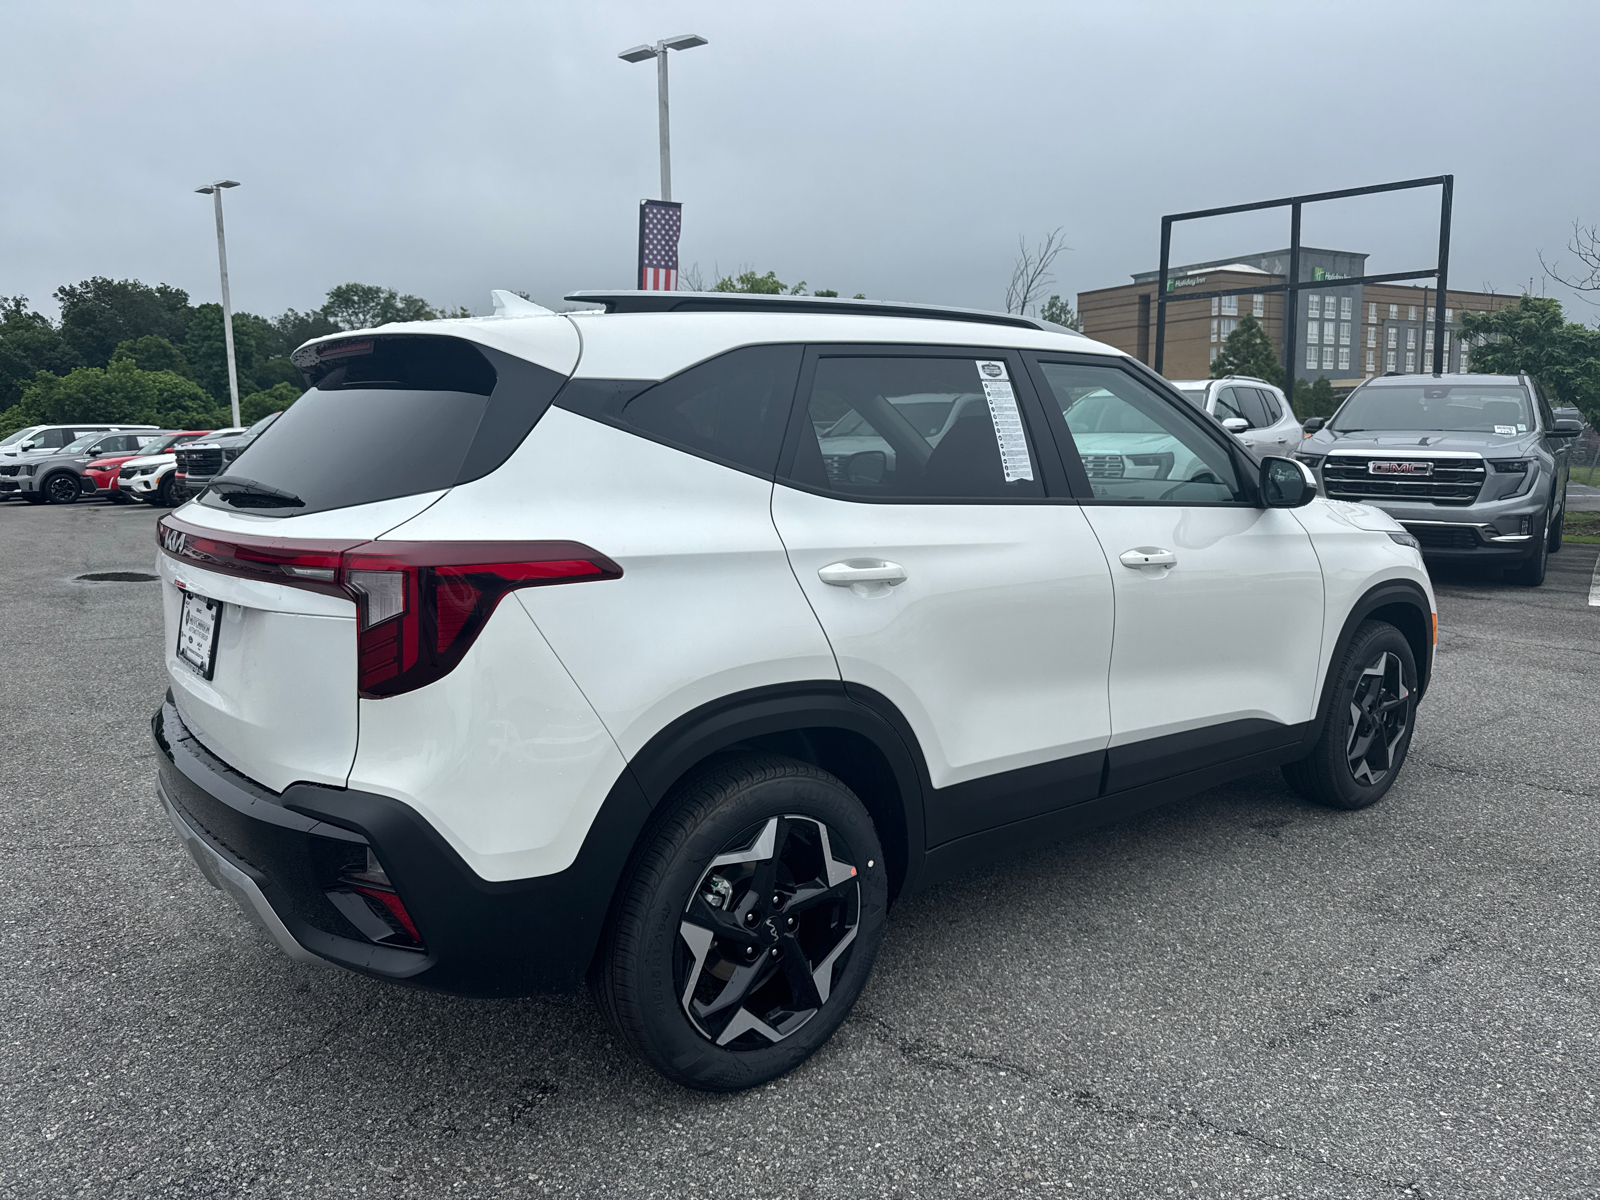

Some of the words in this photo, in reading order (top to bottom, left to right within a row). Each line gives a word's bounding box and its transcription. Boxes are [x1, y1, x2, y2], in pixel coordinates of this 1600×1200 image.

[1175, 278, 1195, 287] Holiday
[1196, 276, 1206, 284] Inn
[1372, 462, 1429, 474] GMC
[164, 529, 186, 554] KIA
[792, 785, 858, 825] KUMHO
